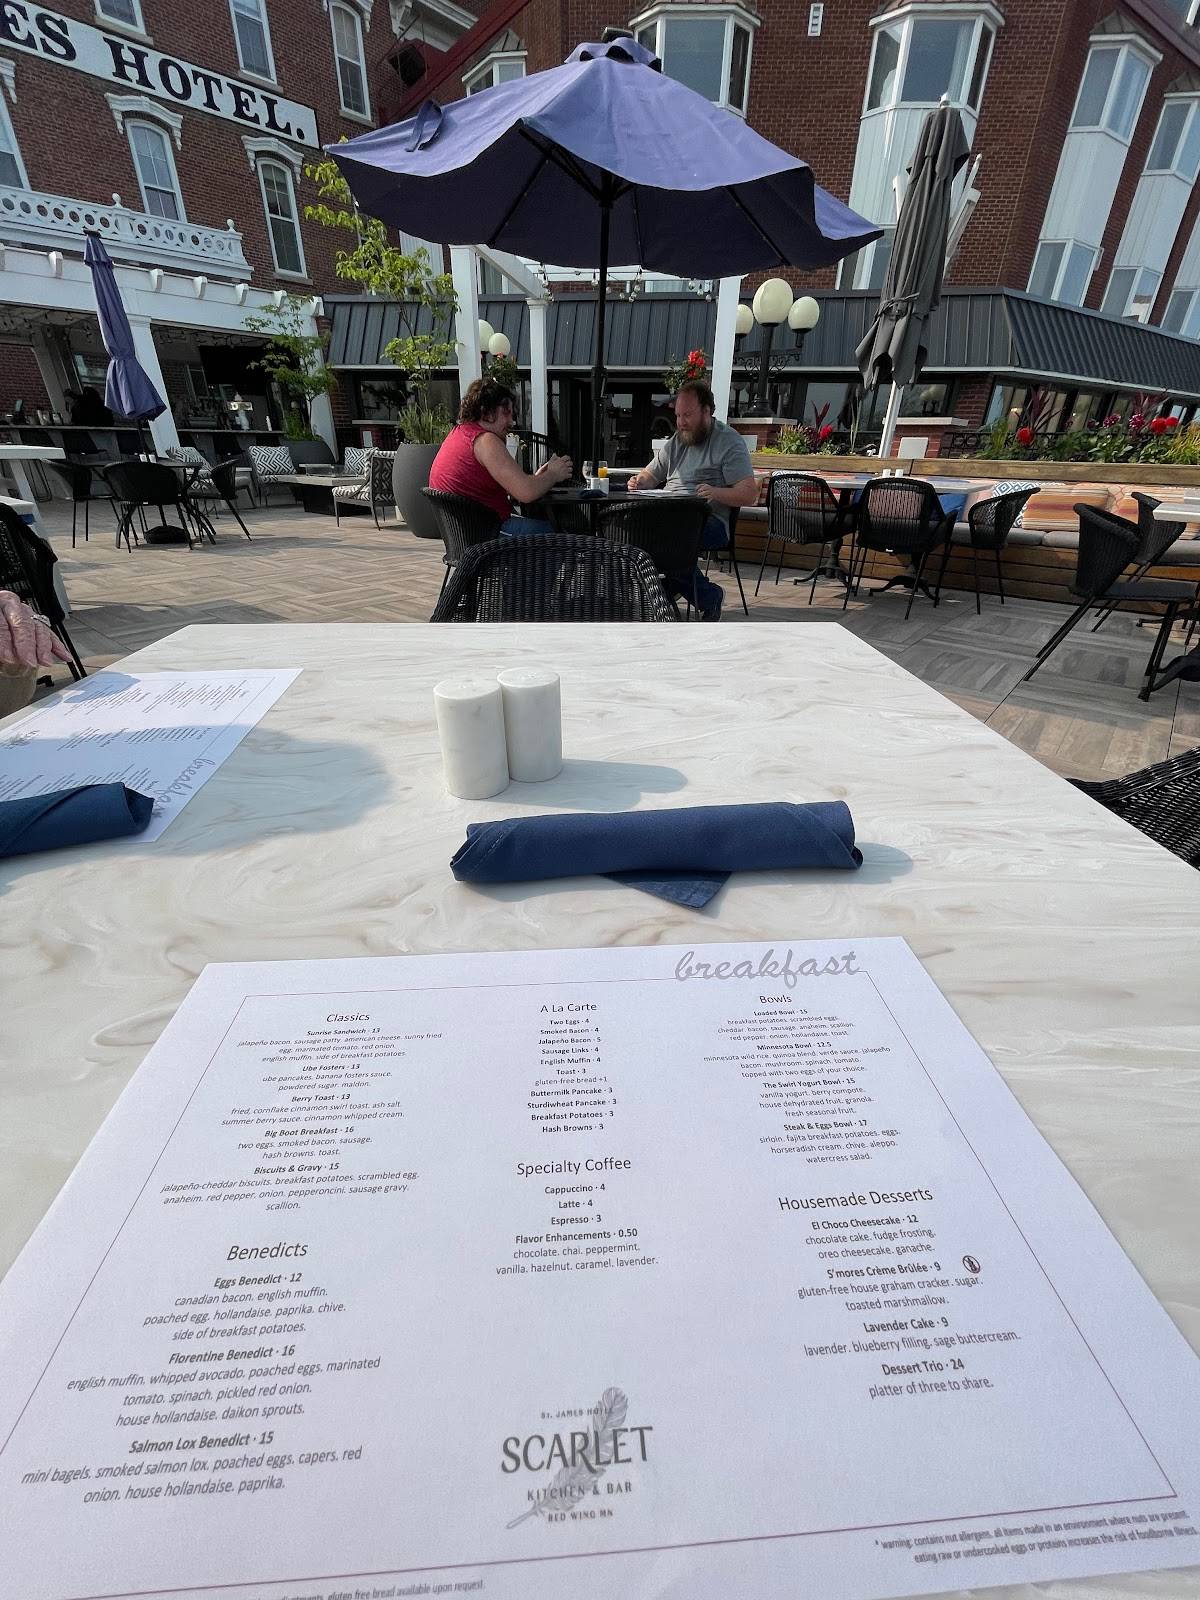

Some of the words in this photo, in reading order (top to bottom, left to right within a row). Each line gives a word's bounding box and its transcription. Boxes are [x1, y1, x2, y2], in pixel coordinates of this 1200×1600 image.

[103, 36, 305, 140] HOTEL.
[674, 949, 861, 989] breakfast
[759, 994, 792, 1003] Bowls
[540, 1005, 548, 1013] A
[552, 1004, 563, 1012] La
[567, 1003, 596, 1011] Carte
[326, 1013, 370, 1022] Classics
[540, 1058, 565, 1066] English
[531, 1089, 570, 1097] Buttermilk
[572, 1087, 602, 1095] Pancake
[527, 1101, 573, 1109] Sturdiwheat
[531, 1113, 567, 1121] Breakfast
[264, 1130, 278, 1138] Big
[299, 1127, 339, 1135] Breakfast
[542, 1125, 561, 1133] Hash
[814, 1122, 832, 1130] Eggs
[262, 1151, 282, 1159] hash
[284, 1150, 316, 1158] browns.
[318, 1148, 341, 1156] toast.
[254, 1165, 287, 1174] Biscuits
[297, 1164, 323, 1173] Gravy
[330, 1162, 339, 1170] 15
[516, 1160, 581, 1178] Specialty
[585, 1157, 630, 1171] Coffee
[544, 1184, 593, 1195] Cappuccino
[558, 1200, 580, 1208] Latte
[778, 1192, 867, 1210] Housemade
[868, 1189, 933, 1204] Desserts
[551, 1217, 589, 1226] Espresso
[596, 1214, 601, 1222] 3
[811, 1221, 820, 1230] El
[821, 1220, 848, 1229] Choco
[850, 1216, 901, 1227] Cheesecake
[906, 1214, 918, 1223] 12
[516, 1235, 543, 1244] Flavor
[545, 1230, 611, 1242] Enhancements
[618, 1228, 637, 1237] 0.50
[226, 1242, 309, 1260] Benedicts
[866, 1265, 897, 1276] Crème
[897, 1262, 928, 1273] Brûlée
[933, 1262, 940, 1271] 9
[214, 1278, 236, 1289] Eggs
[238, 1274, 282, 1285] Benedict
[290, 1272, 302, 1282] 12
[845, 1298, 882, 1310] toasted
[883, 1294, 948, 1308] marshmallow.
[862, 1319, 908, 1332] Lavender
[910, 1318, 935, 1329] Cake
[941, 1316, 948, 1327] 9
[169, 1350, 224, 1364] Florentine
[226, 1346, 274, 1360] Benedict
[283, 1345, 295, 1356] 16
[881, 1362, 922, 1375] Dessert
[921, 1360, 943, 1372] Trio
[949, 1358, 964, 1370] 24
[123, 1393, 166, 1405] tomato.
[169, 1388, 213, 1406] spinach.
[215, 1384, 257, 1403] pickled
[257, 1383, 278, 1396] red
[279, 1382, 312, 1395] onion.
[868, 1384, 903, 1400] platter
[906, 1381, 917, 1394] of
[918, 1380, 947, 1393] three
[947, 1380, 960, 1390] to
[961, 1377, 994, 1389] share.
[556, 1408, 583, 1418] JAMES
[129, 1439, 173, 1453] Salmon
[175, 1437, 197, 1450] Lox
[198, 1433, 251, 1448] Benedict
[260, 1431, 274, 1444] 15
[501, 1426, 653, 1474] SCARLET
[22, 1469, 50, 1483] mini
[51, 1466, 91, 1484] bagels.
[95, 1461, 143, 1478] smoked
[144, 1460, 188, 1474] salmon
[190, 1458, 209, 1471] lox.
[211, 1453, 265, 1474] poached
[266, 1454, 295, 1469] eggs.
[298, 1451, 338, 1467] capers.
[342, 1445, 363, 1460] red
[84, 1487, 121, 1502] onion.
[124, 1485, 162, 1499] house
[164, 1479, 234, 1496] hollandaise.
[236, 1475, 285, 1495] paprika.
[527, 1485, 585, 1501] KITCHEN
[592, 1485, 600, 1496] &
[607, 1481, 632, 1495] BAR
[548, 1513, 566, 1522] RED
[571, 1511, 596, 1521] WING
[600, 1509, 613, 1518] MN
